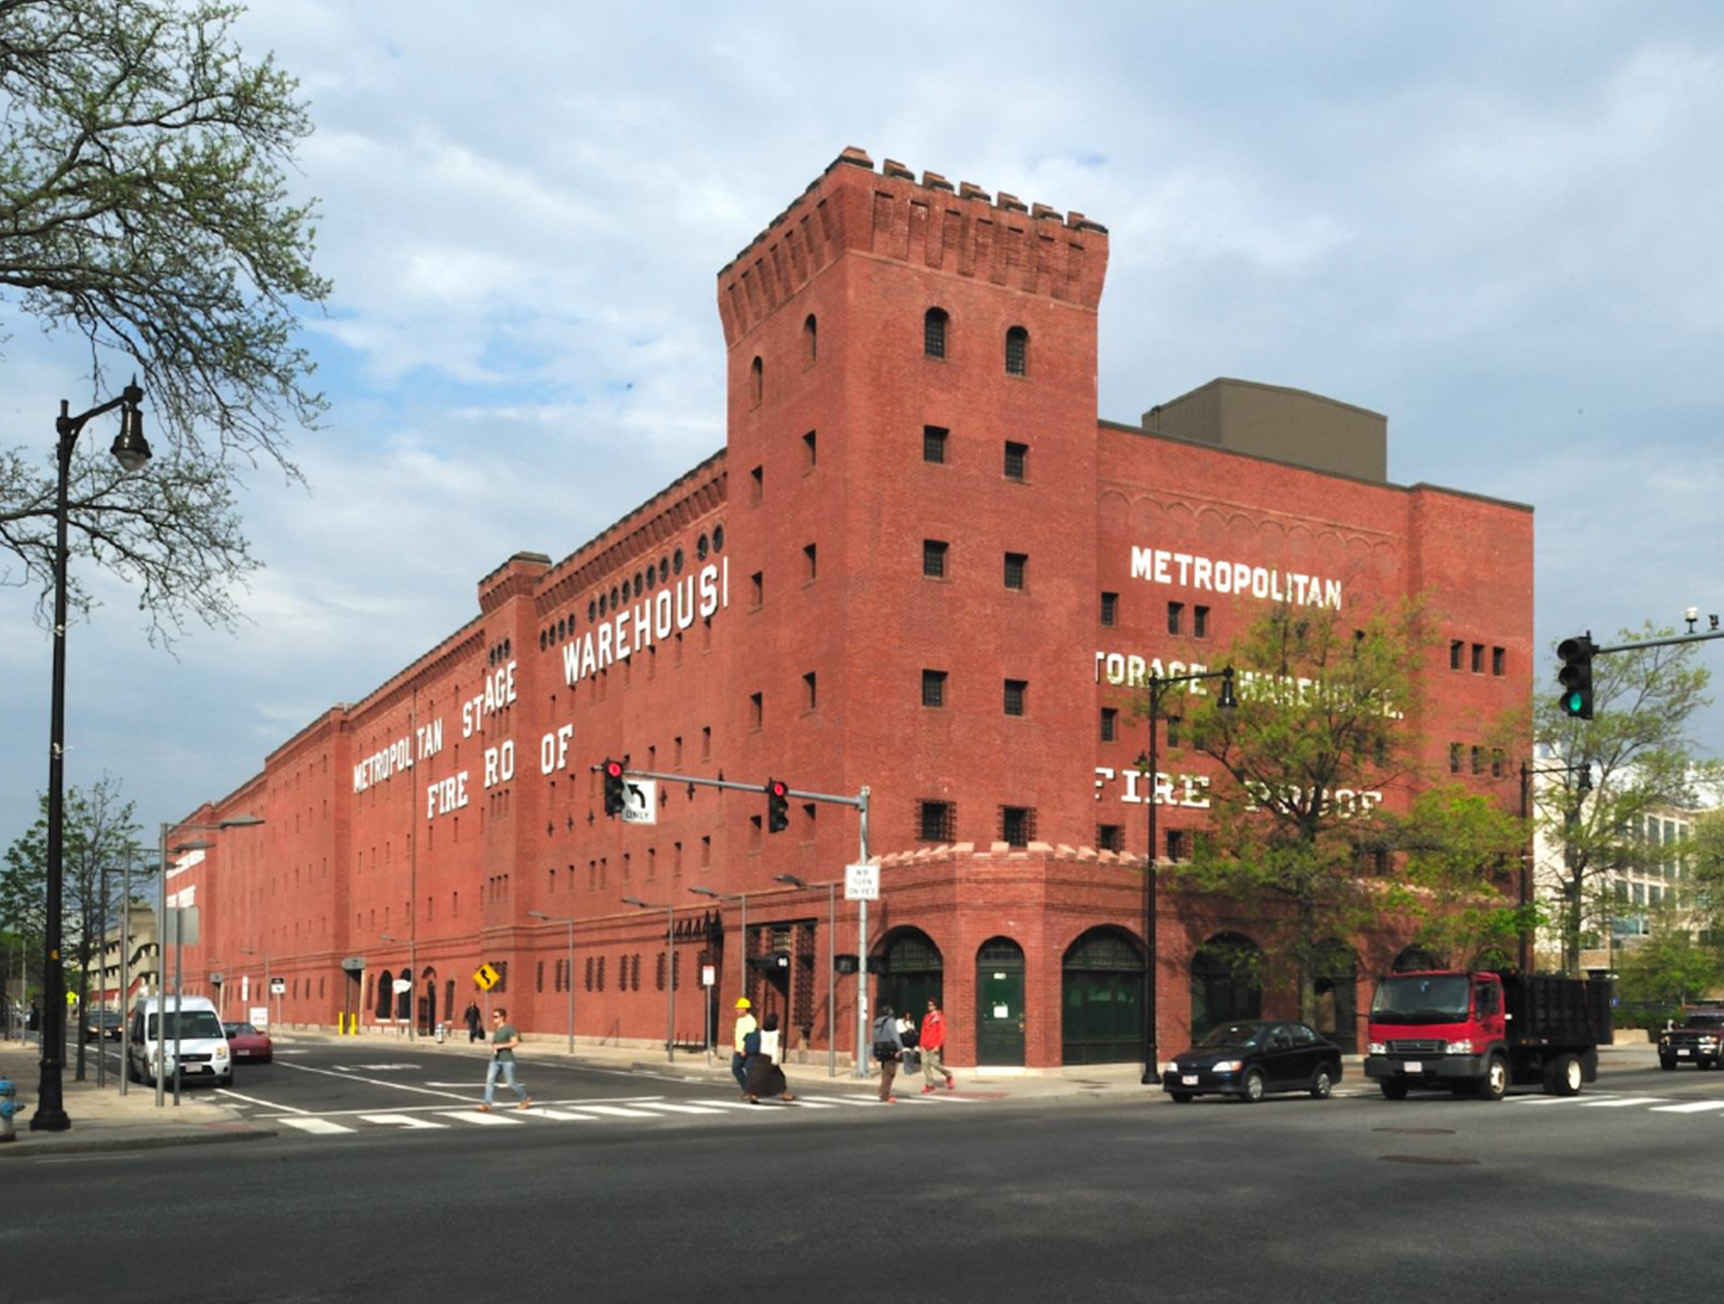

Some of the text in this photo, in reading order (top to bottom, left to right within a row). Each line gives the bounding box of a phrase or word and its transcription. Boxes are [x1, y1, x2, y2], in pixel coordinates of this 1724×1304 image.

[1131, 546, 1341, 610] METROPOLITAN
[427, 771, 469, 819] FIRE
[626, 809, 649, 820] ONLY
[856, 868, 869, 876] NO
[853, 877, 872, 886] TURN
